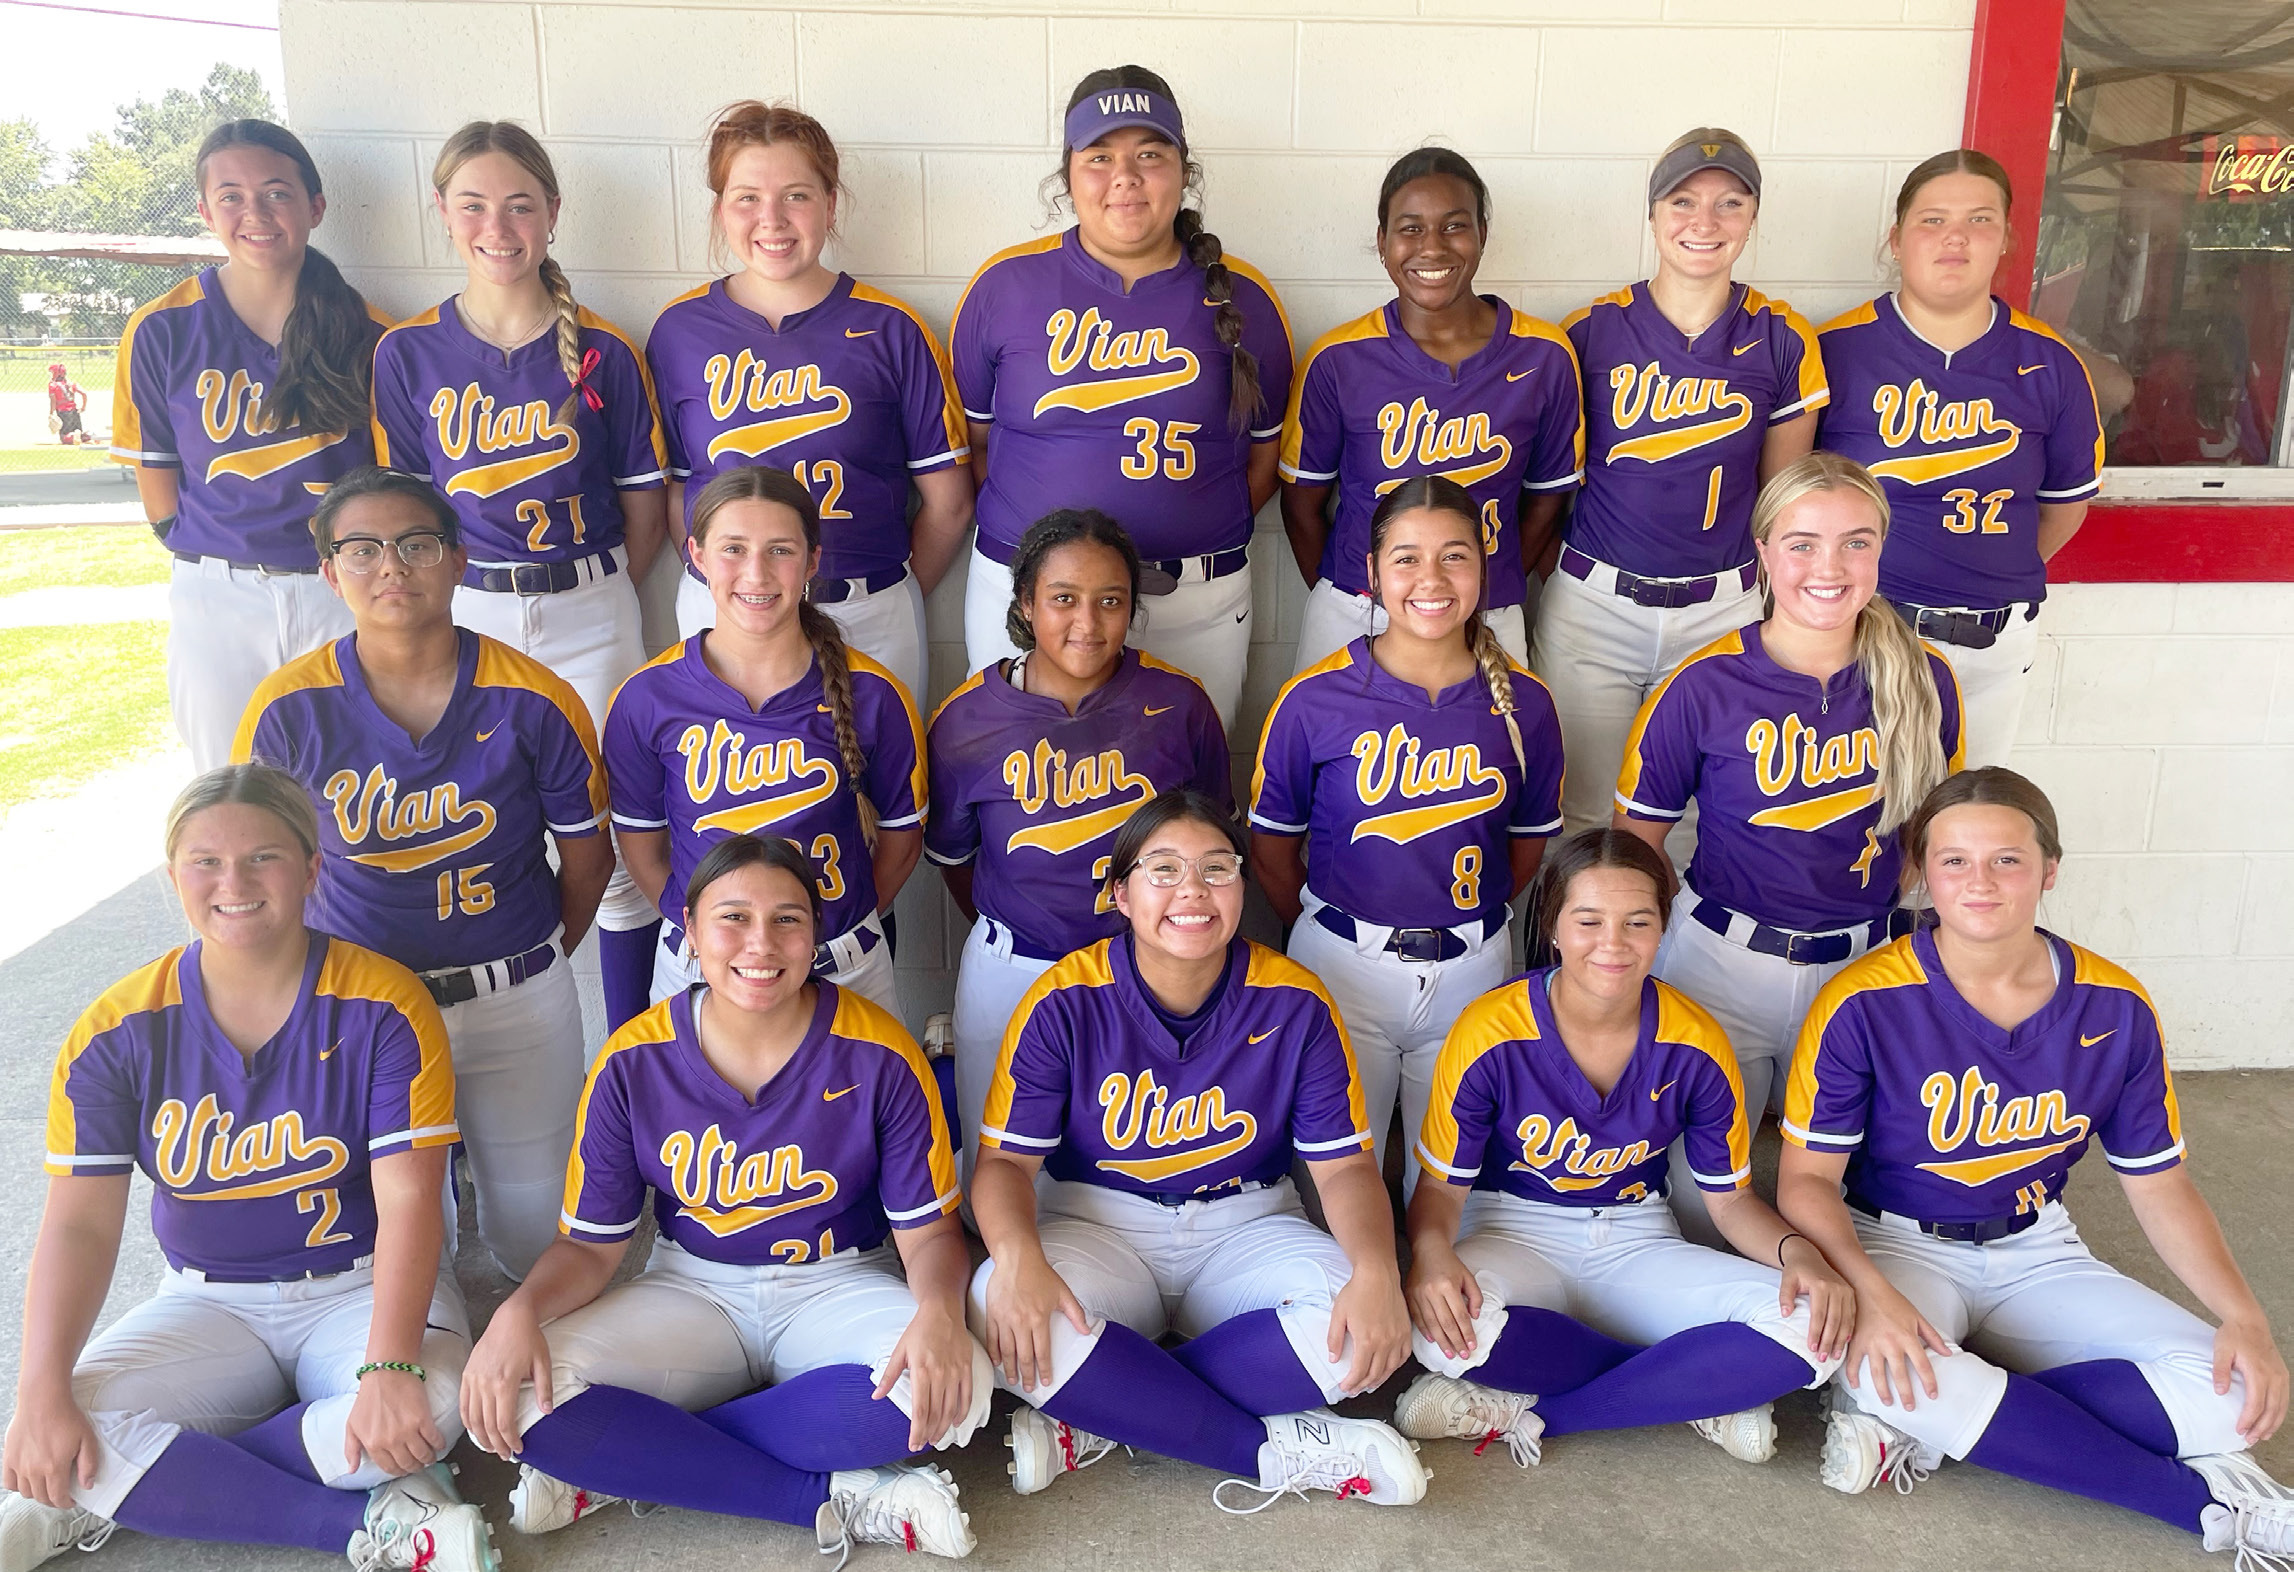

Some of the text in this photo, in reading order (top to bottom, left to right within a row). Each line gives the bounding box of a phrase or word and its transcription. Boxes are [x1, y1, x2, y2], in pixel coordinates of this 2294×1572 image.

[1098, 93, 1151, 115] VIAN
[1045, 306, 1199, 377] Vian
[704, 347, 852, 421] Vian
[1608, 360, 1753, 430] Vian
[1873, 378, 2022, 447] Vian
[429, 381, 580, 461] Vian
[1119, 417, 1202, 480] 35
[1377, 396, 1513, 469] Vian
[515, 494, 586, 552] 27
[1702, 465, 1723, 531] 1
[1942, 488, 2014, 534] 32
[677, 717, 839, 804] Vian
[1002, 736, 1157, 815] Vian
[1351, 721, 1507, 806] Vian
[1745, 712, 1881, 797] Vian
[324, 762, 497, 845] Vian
[437, 862, 496, 921] 15
[1451, 845, 1483, 911] 8
[151, 1092, 350, 1188] Vian
[1098, 1068, 1258, 1150] Vian
[1516, 1113, 1667, 1177] Vian
[1920, 1065, 2091, 1153] Vian
[660, 1123, 839, 1208] Vian
[296, 1188, 354, 1248] 2
